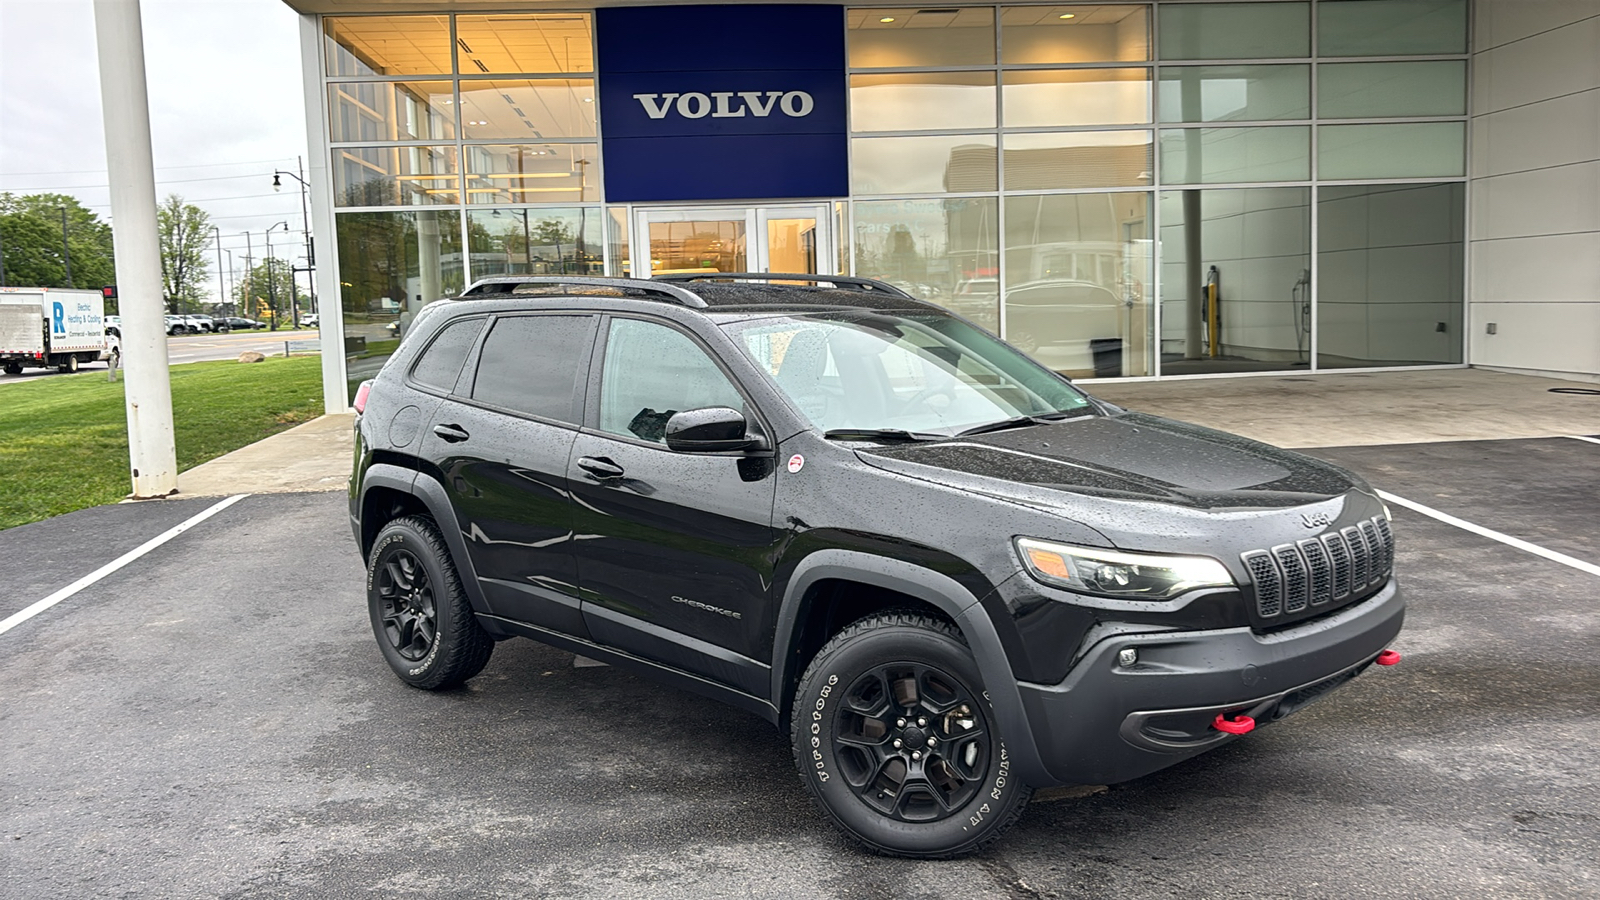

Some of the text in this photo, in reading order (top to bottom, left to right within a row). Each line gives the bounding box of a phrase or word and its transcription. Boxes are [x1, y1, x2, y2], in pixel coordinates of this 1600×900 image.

[632, 91, 814, 119] VOLVO
[856, 221, 891, 234] Cars
[53, 302, 66, 333] R
[77, 303, 91, 311] Electric
[68, 315, 82, 324] Heating
[88, 315, 101, 324] Cooling
[1300, 512, 1332, 528] Jeep
[671, 595, 742, 619] CHEROKEE
[811, 674, 838, 782] Firestone
[969, 803, 991, 827] A/T
